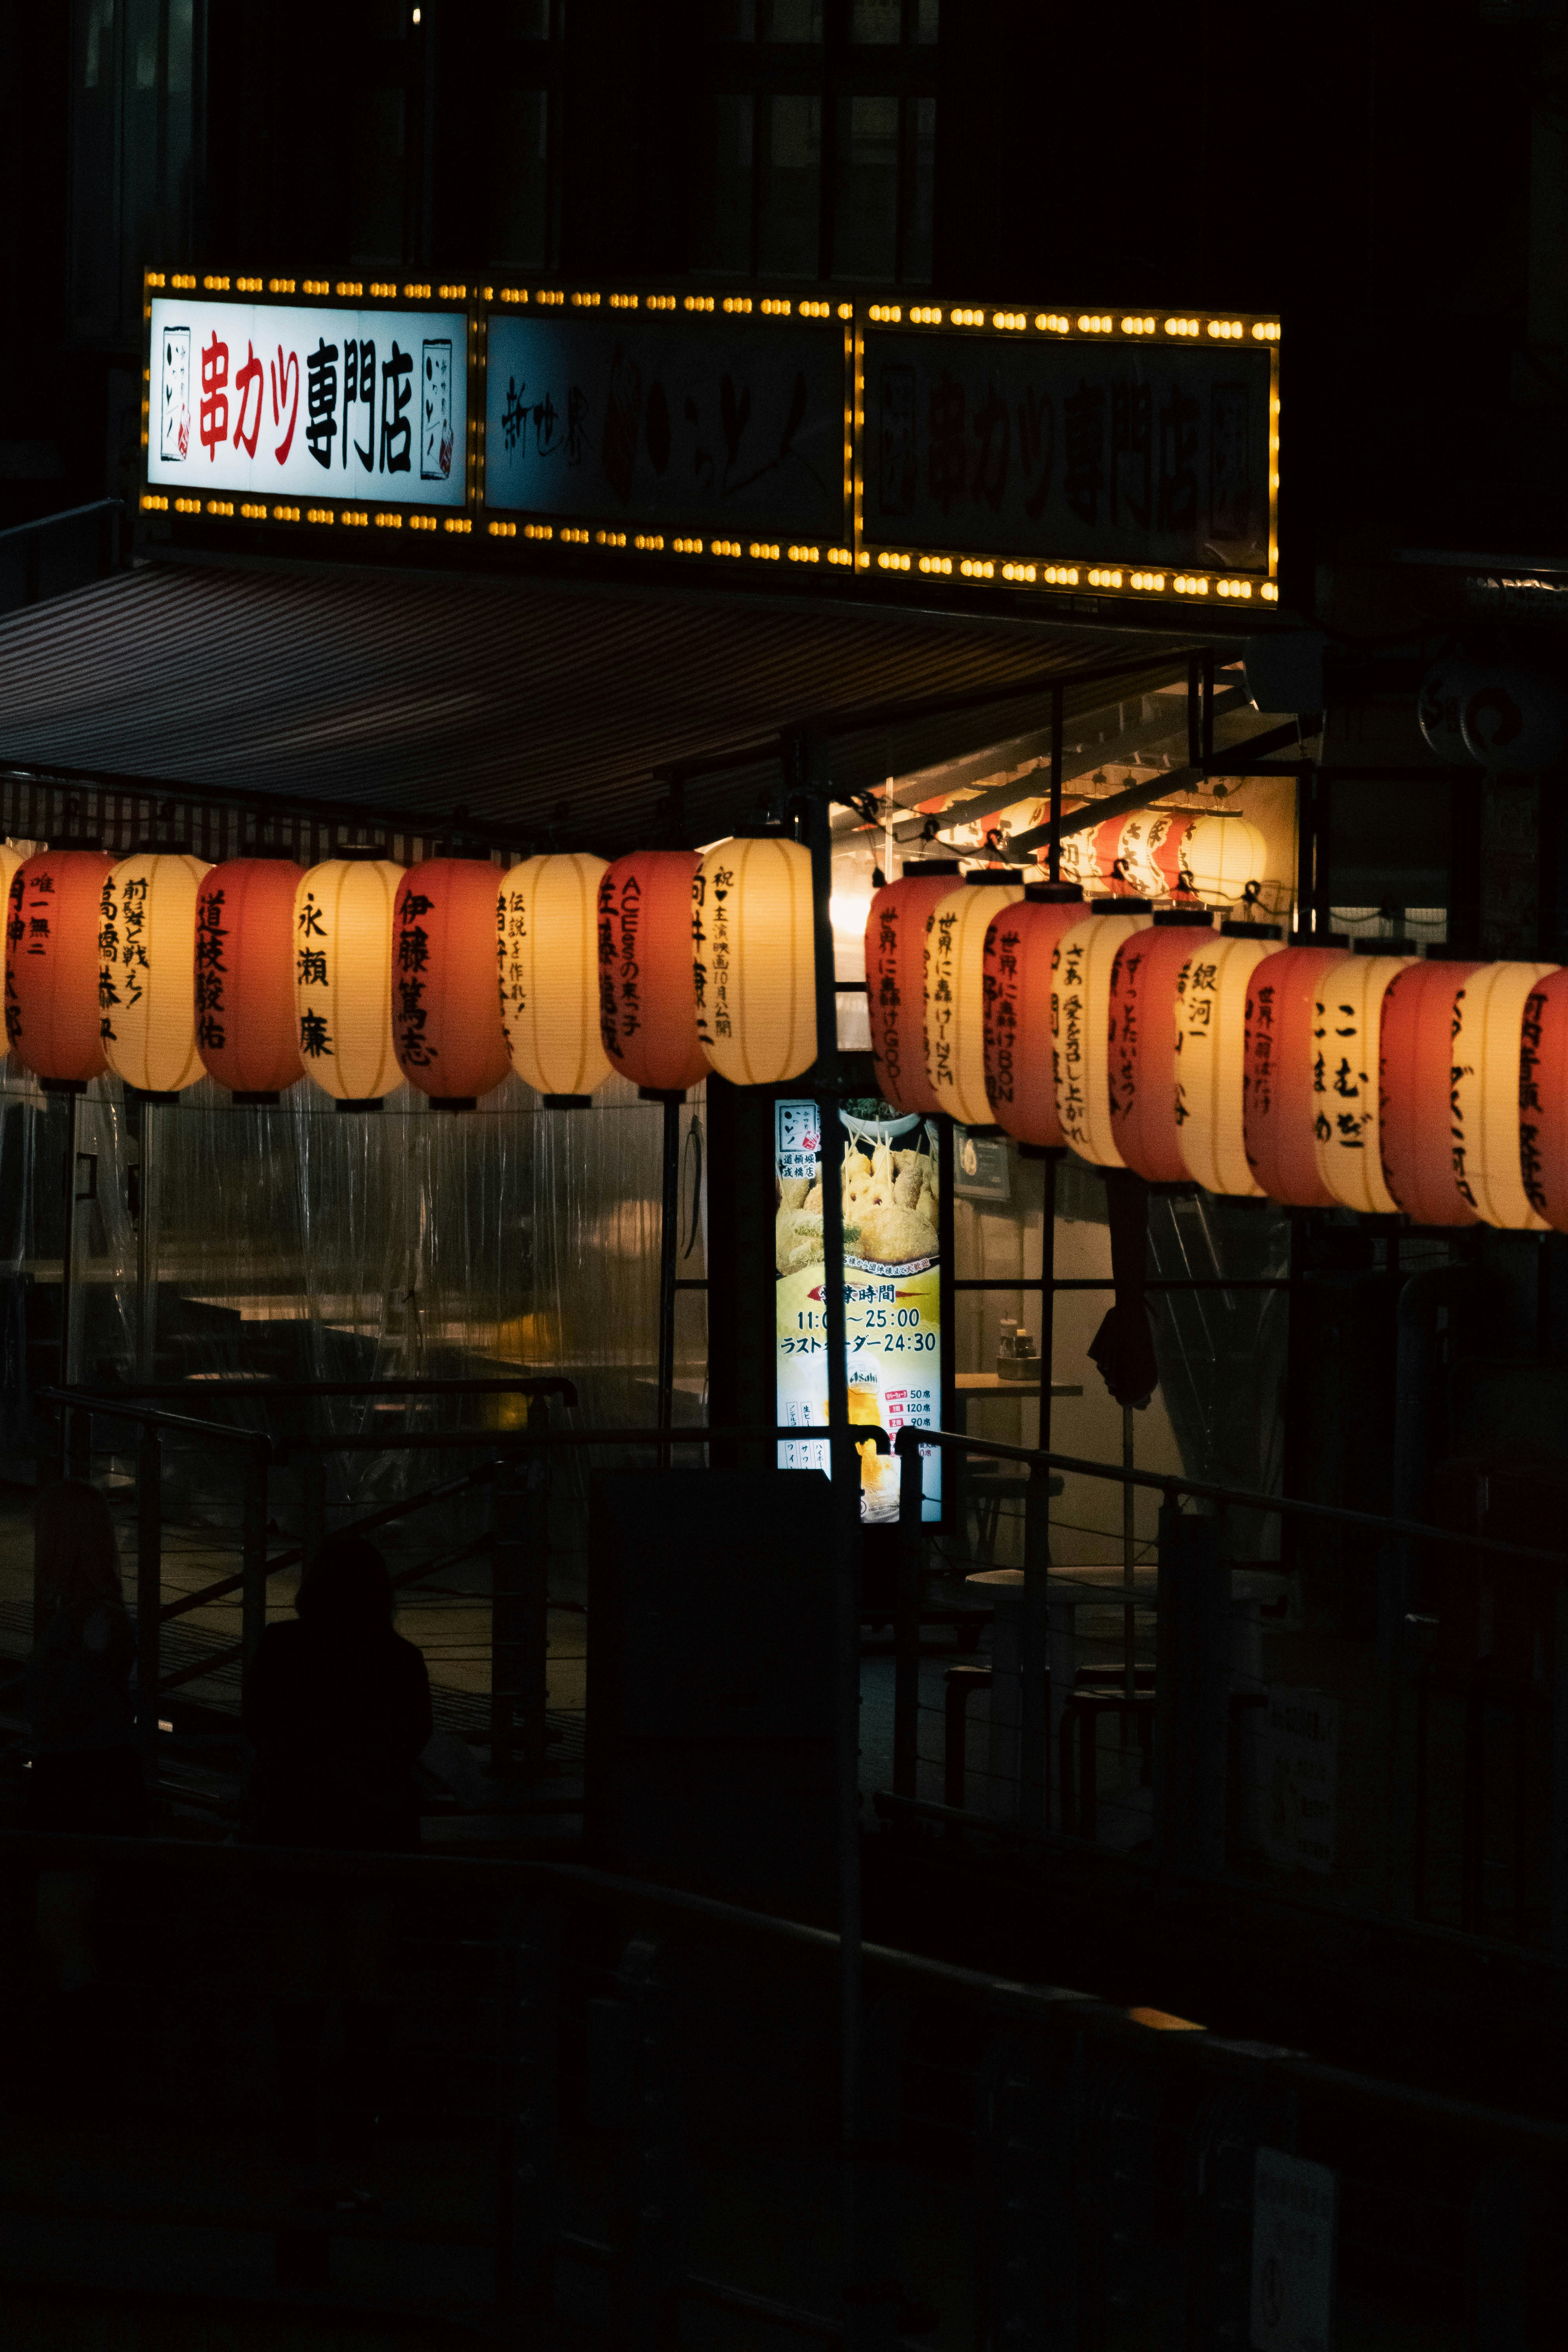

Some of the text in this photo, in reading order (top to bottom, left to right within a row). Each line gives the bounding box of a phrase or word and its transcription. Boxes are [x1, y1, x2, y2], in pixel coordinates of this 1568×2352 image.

[200, 330, 413, 474] 串カツ専門店
[503, 376, 594, 466] 新世界
[27, 872, 55, 955] 唯一無二
[398, 889, 438, 1067] 伊藤篤志
[1189, 962, 1218, 1036] 銀河一
[784, 1154, 814, 1164] 道頓堀
[784, 1167, 814, 1177] 戎橋店
[849, 1371, 878, 1383] Asahi
[910, 1390, 930, 1399] 50席
[907, 1403, 930, 1412] 120席
[911, 1417, 931, 1426] 90席
